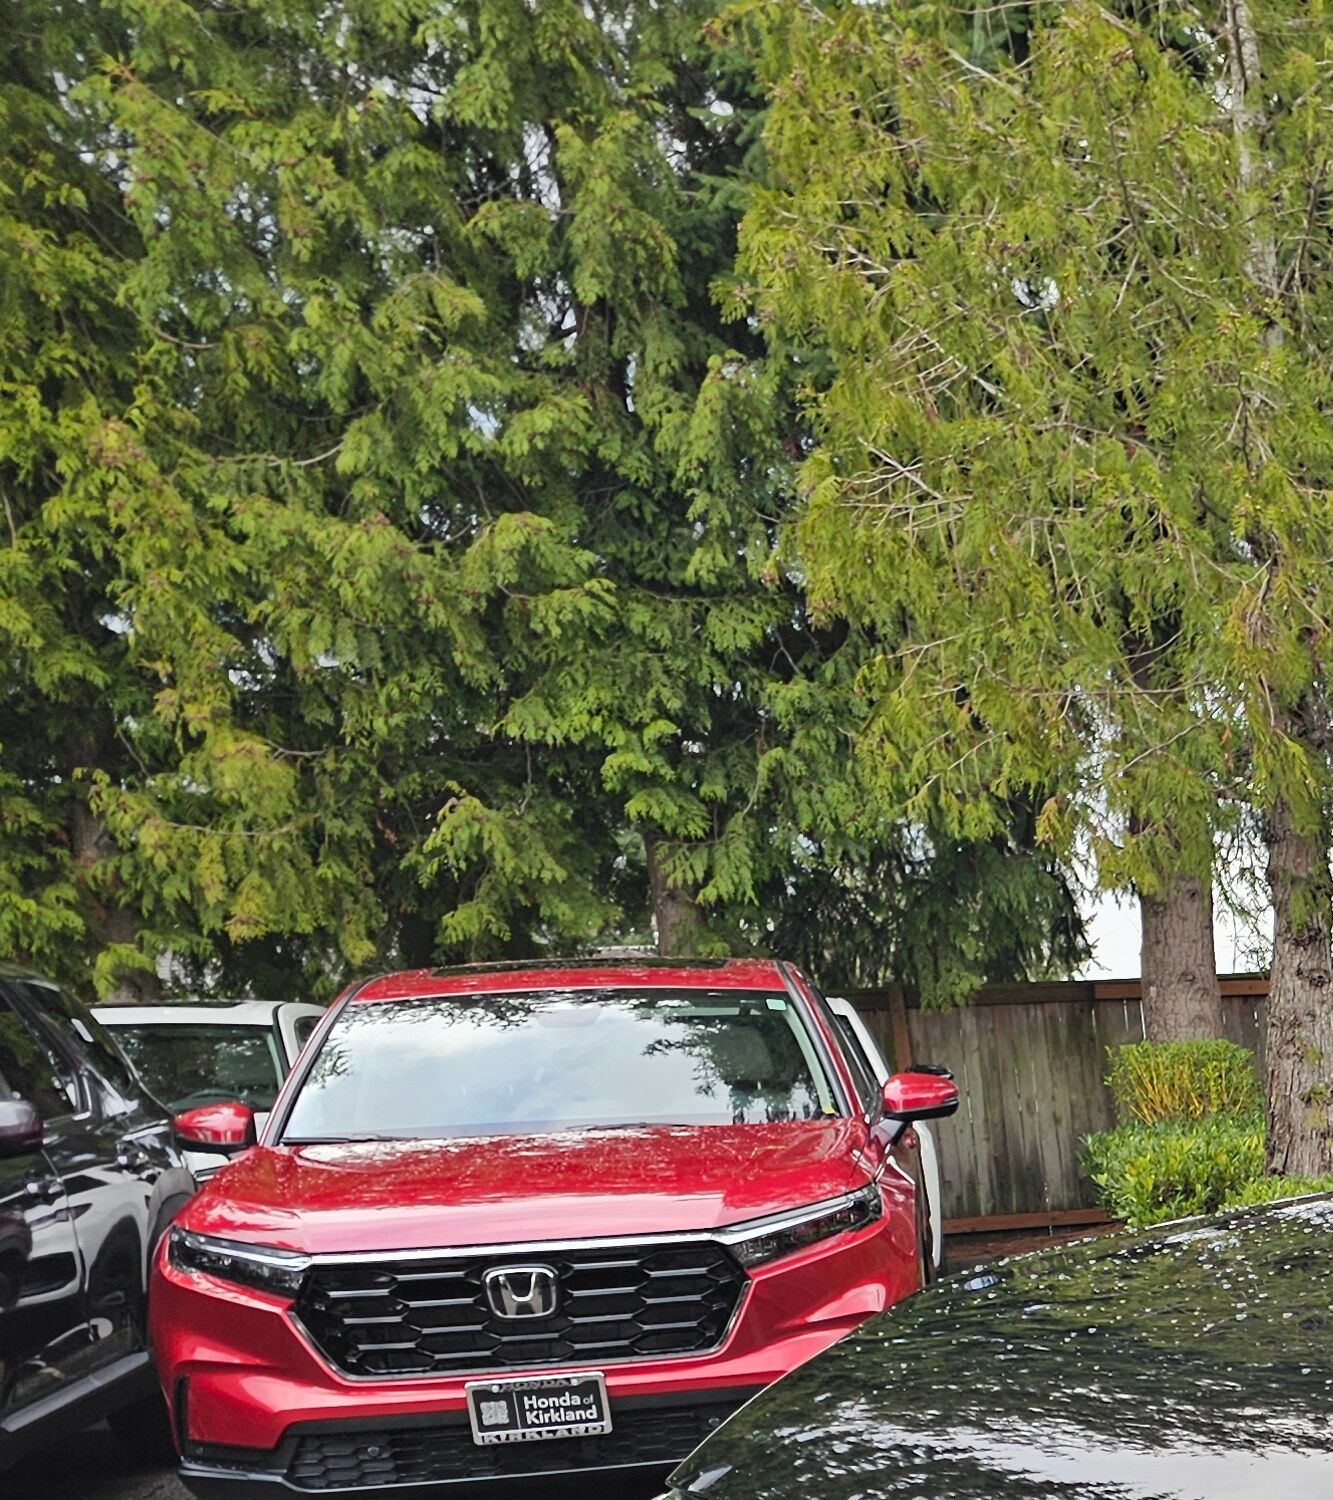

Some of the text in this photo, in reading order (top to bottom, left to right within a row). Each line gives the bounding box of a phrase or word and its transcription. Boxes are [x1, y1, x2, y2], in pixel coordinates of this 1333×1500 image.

[502, 1378, 567, 1393] HONDA
[523, 1391, 594, 1411] Honda of
[526, 1404, 598, 1426] Kirkland
